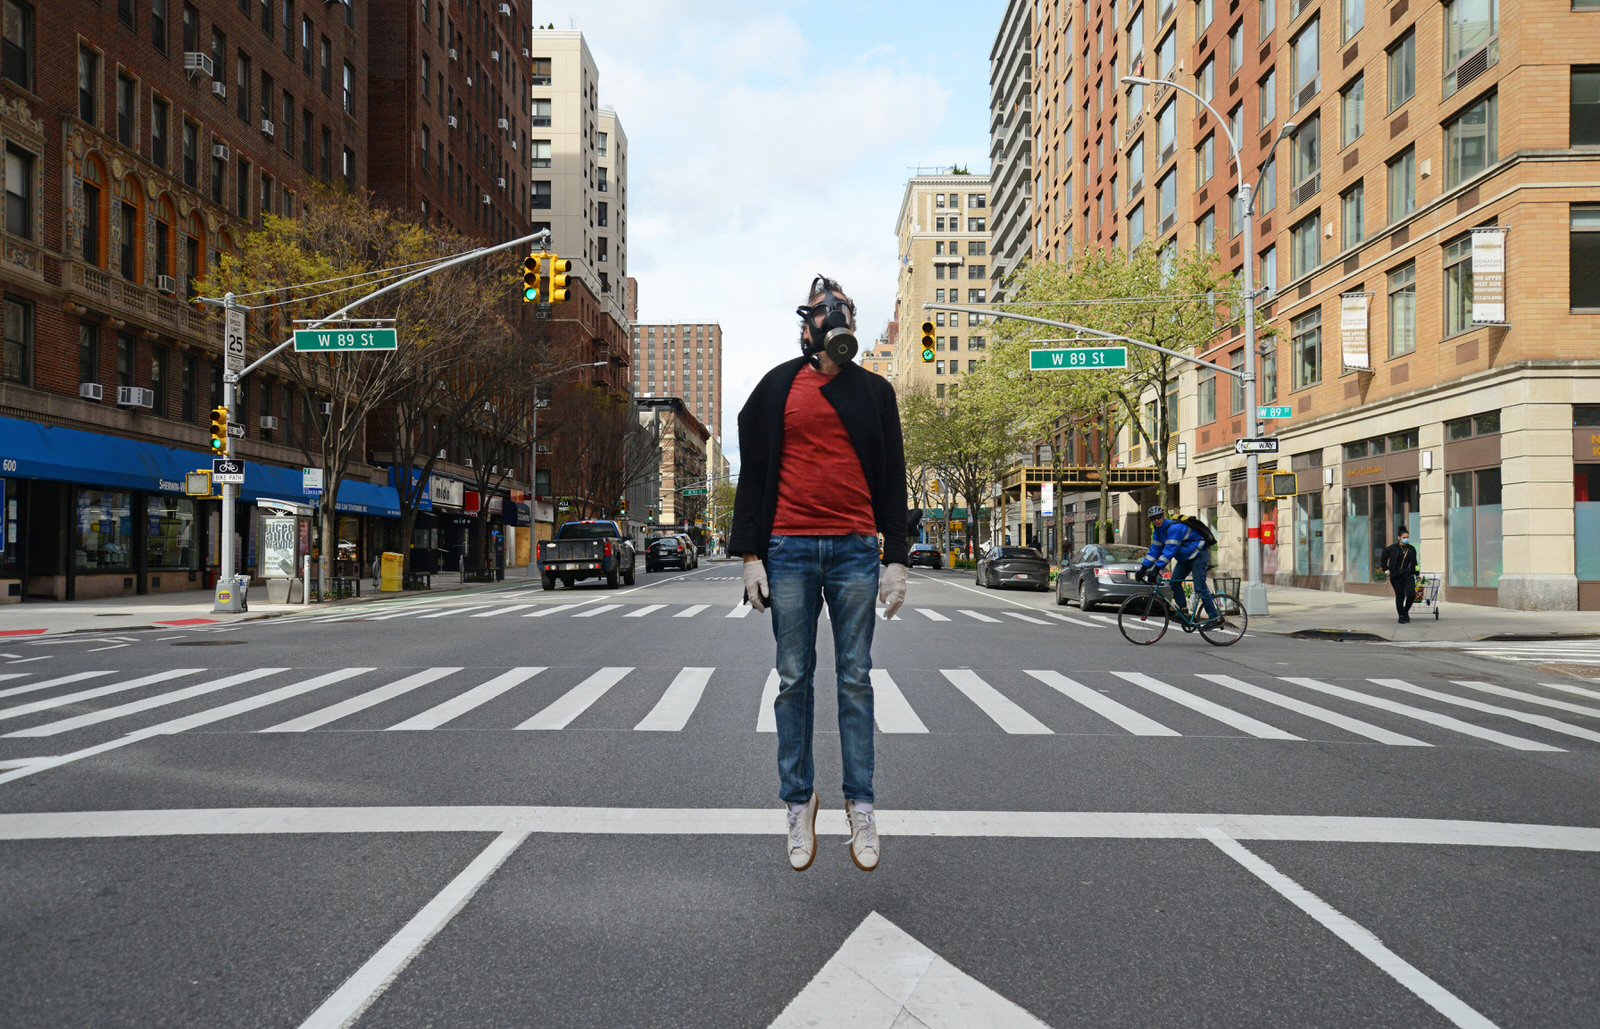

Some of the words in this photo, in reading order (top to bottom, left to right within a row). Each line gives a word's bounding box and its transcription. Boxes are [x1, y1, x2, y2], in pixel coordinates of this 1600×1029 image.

[230, 319, 241, 328] SPEED
[229, 334, 243, 354] 25
[318, 334, 330, 347] W
[337, 333, 354, 346] 89
[361, 333, 375, 346] St
[1051, 353, 1064, 366] W
[1070, 352, 1086, 365] 89
[1092, 351, 1105, 364] St
[1260, 408, 1267, 417] W
[1270, 407, 1281, 417] 89
[3, 459, 17, 472] 600
